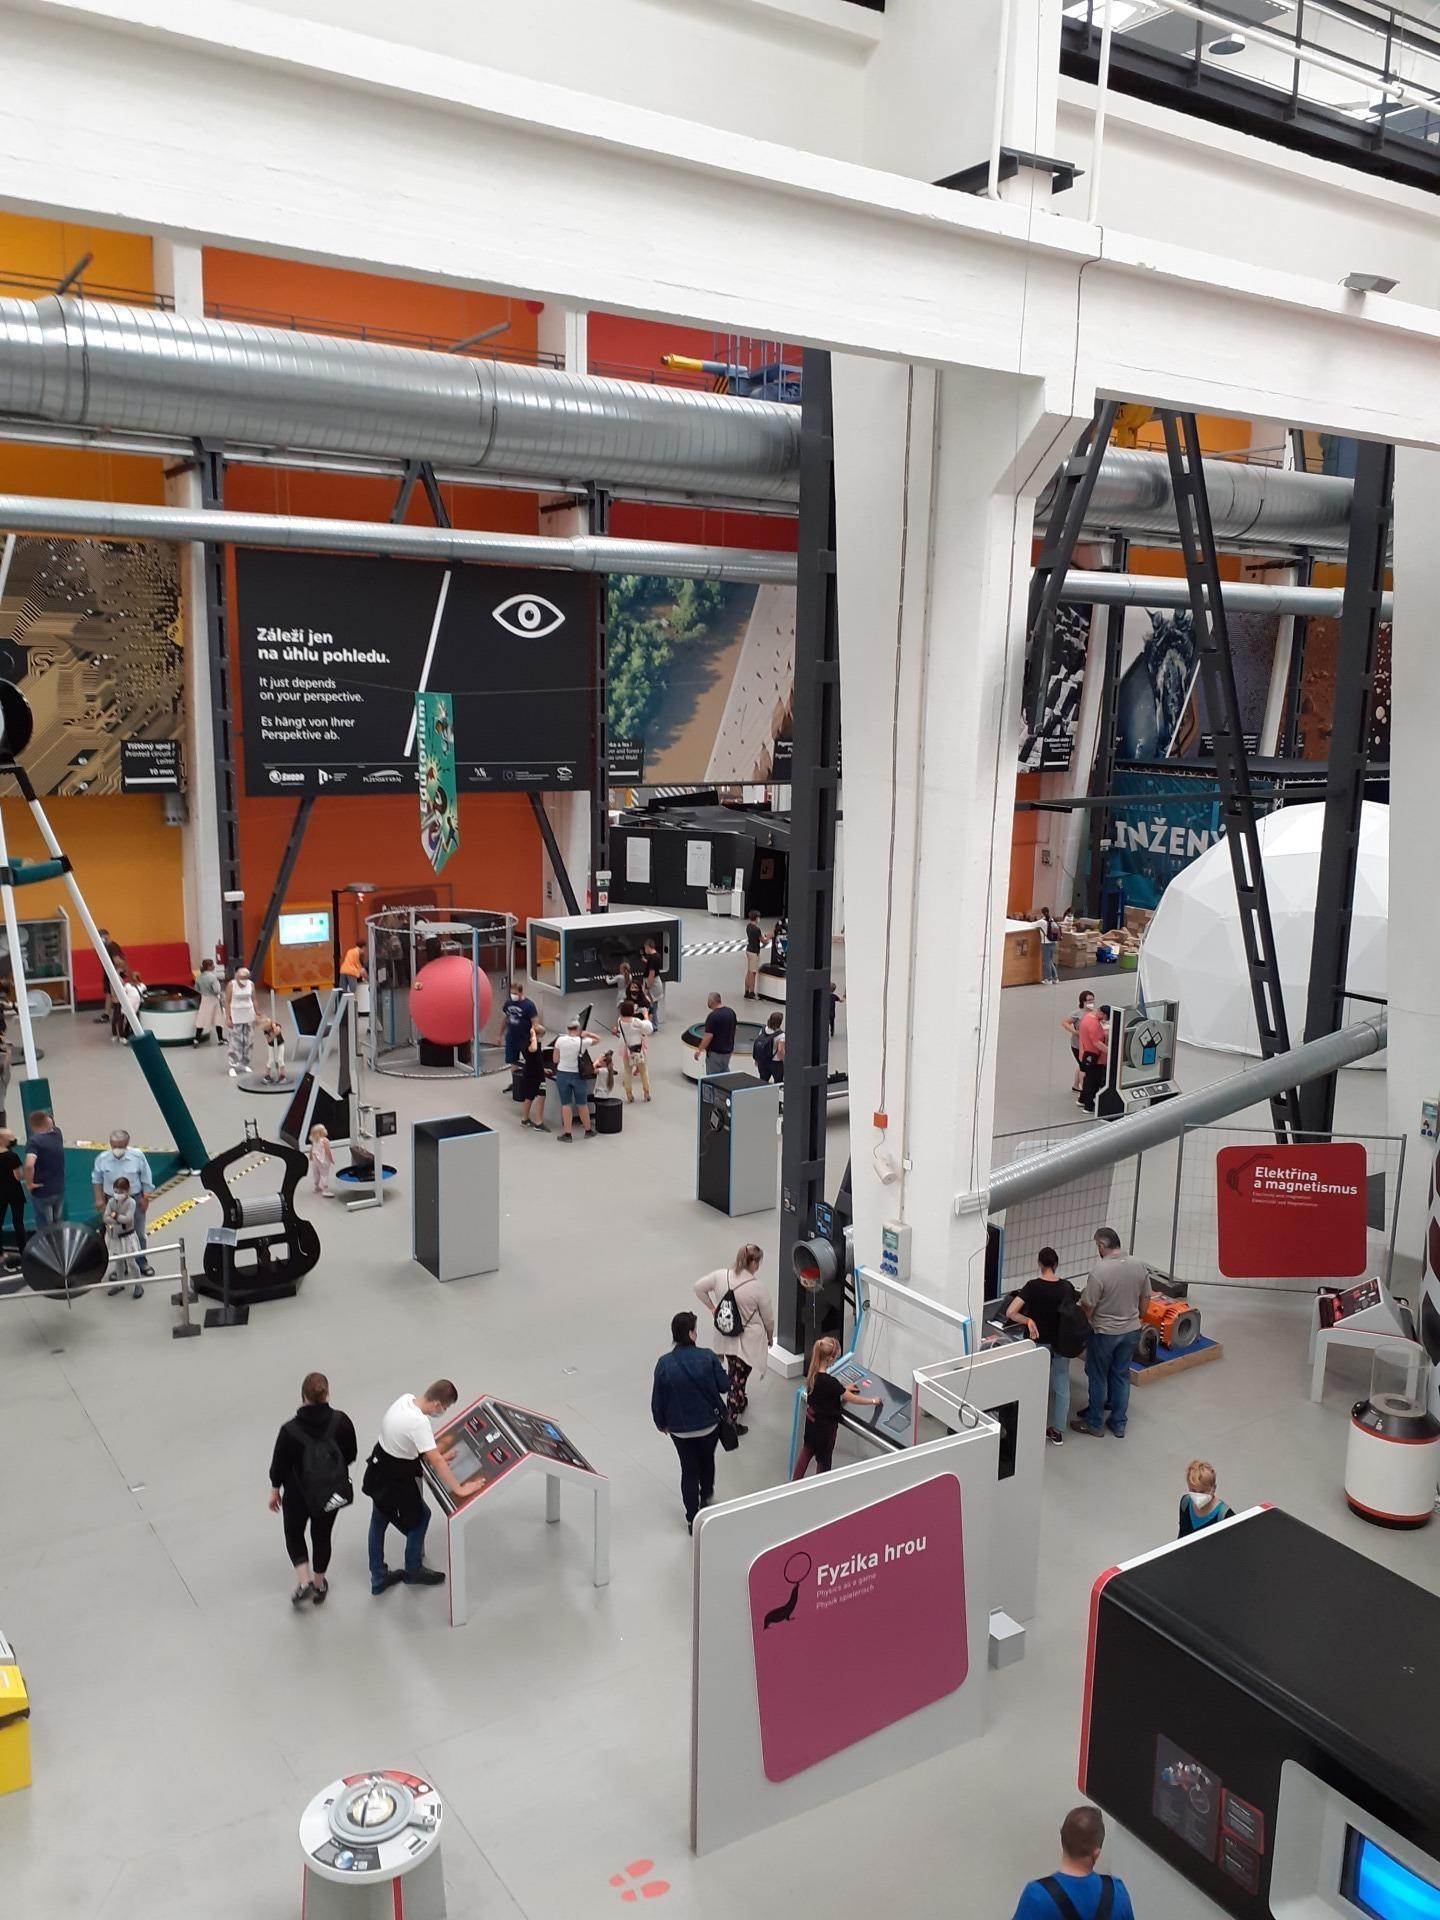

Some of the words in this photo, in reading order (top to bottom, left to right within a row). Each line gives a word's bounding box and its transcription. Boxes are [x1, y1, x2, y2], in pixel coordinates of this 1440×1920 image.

[256, 627, 304, 643] Záleží
[307, 629, 334, 646] jen
[257, 648, 279, 660] na
[282, 646, 319, 661] úhlu
[322, 648, 391, 665] pohledu.
[259, 676, 267, 687] It
[269, 677, 289, 689] just
[291, 677, 336, 690] depends
[259, 691, 274, 700] on
[276, 692, 301, 703] your
[303, 691, 365, 704] perspective.
[260, 716, 273, 727] Es
[274, 716, 306, 729] hängt
[308, 718, 328, 727] von
[330, 716, 355, 727] Ihrer
[261, 729, 322, 741] Perspektive
[324, 730, 340, 740] ab.
[1255, 1166, 1318, 1181] Elektřina
[1253, 1180, 1262, 1188] a
[1265, 1181, 1358, 1195] magnetismus
[817, 1552, 879, 1586] Fyzika
[884, 1536, 927, 1563] hrou
